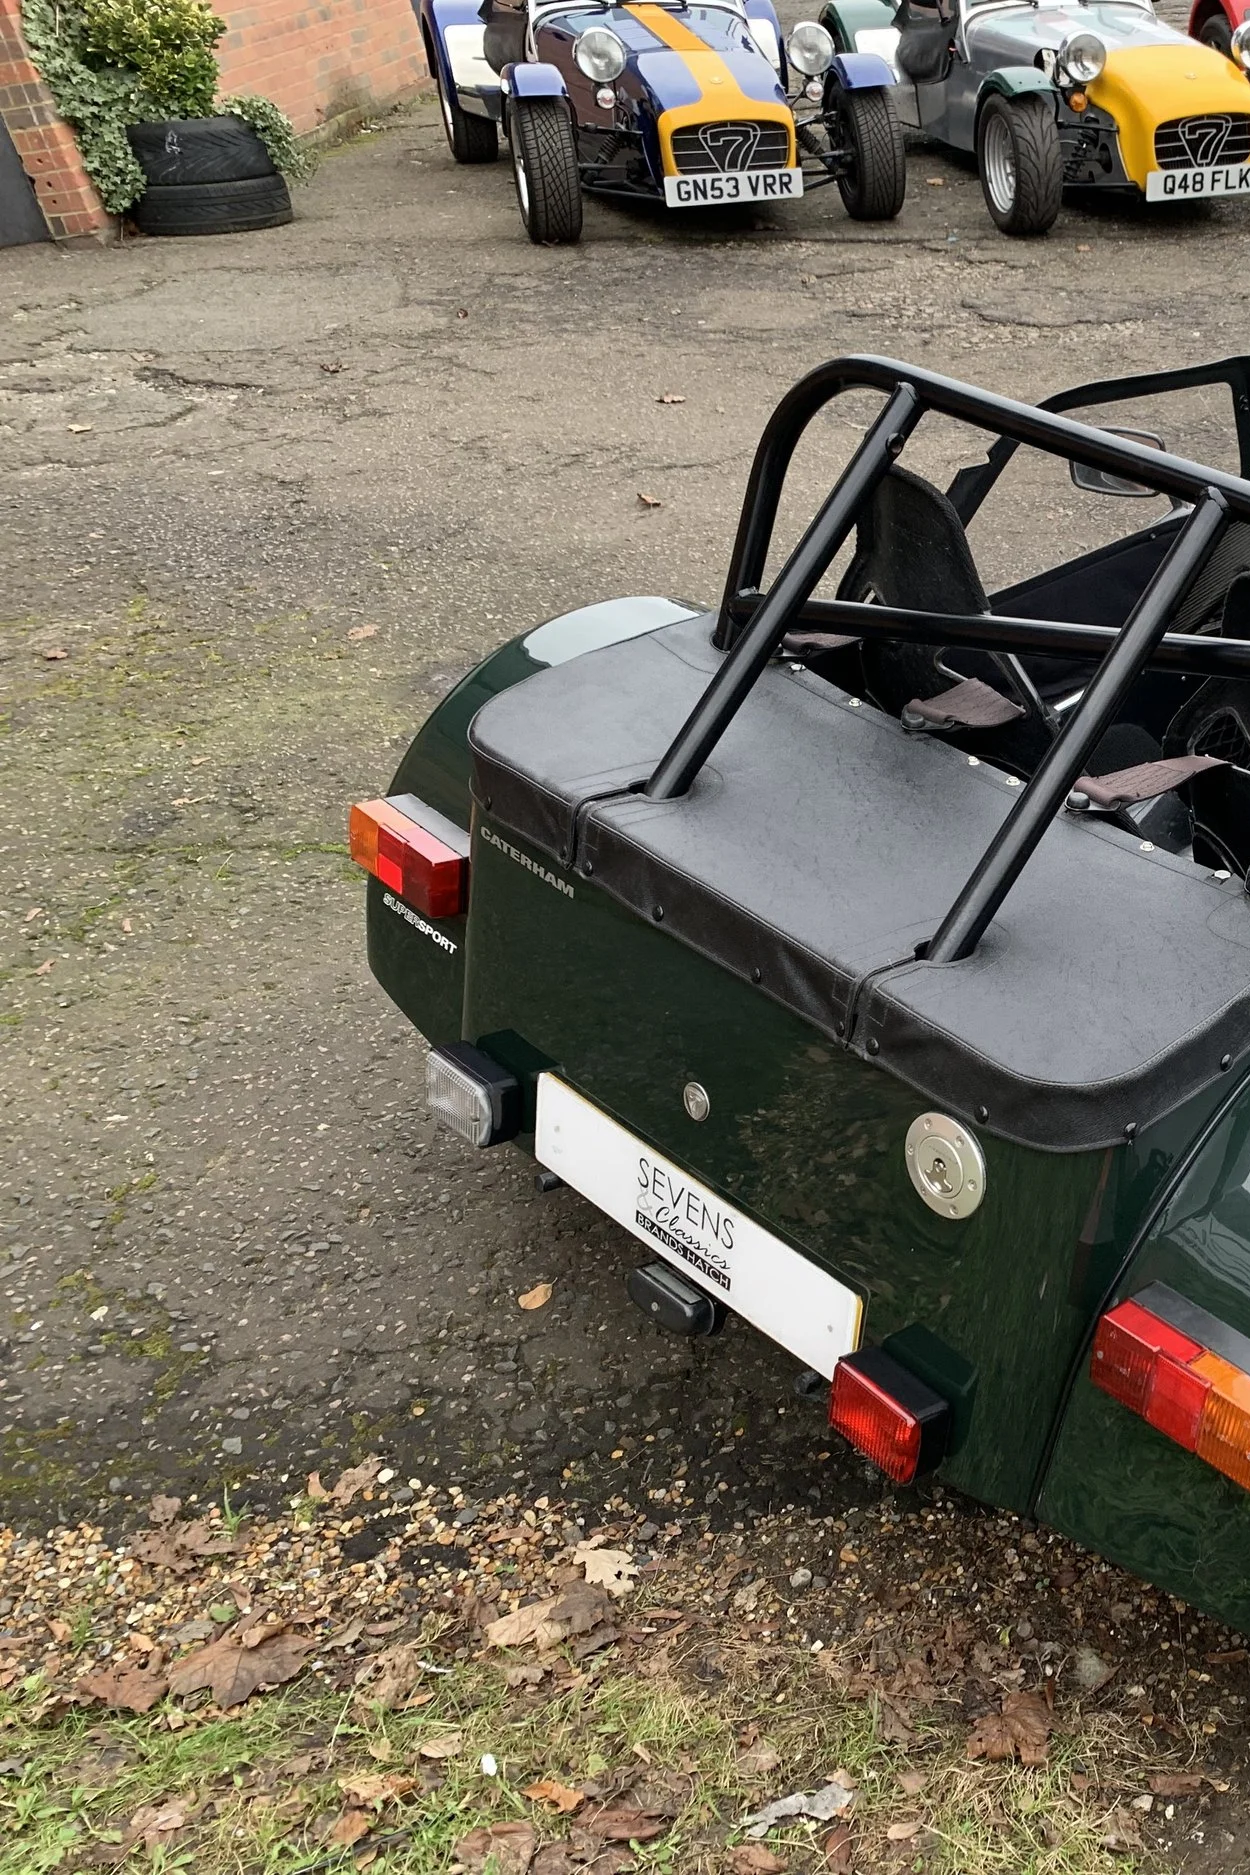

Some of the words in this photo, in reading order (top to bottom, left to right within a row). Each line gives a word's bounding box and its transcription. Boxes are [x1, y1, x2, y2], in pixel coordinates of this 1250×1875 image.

[707, 127, 754, 172] 7
[1185, 120, 1225, 163] 7
[676, 177, 740, 202] GN53
[747, 173, 793, 197] VRR
[1163, 172, 1204, 194] Q48
[480, 826, 575, 899] CATERHAM
[383, 892, 458, 954] SUPERSPORT
[637, 1157, 735, 1250] SEVENS
[637, 1213, 684, 1256] BRANDS
[686, 1251, 729, 1290] HATCH
[655, 1206, 731, 1270] Classics
